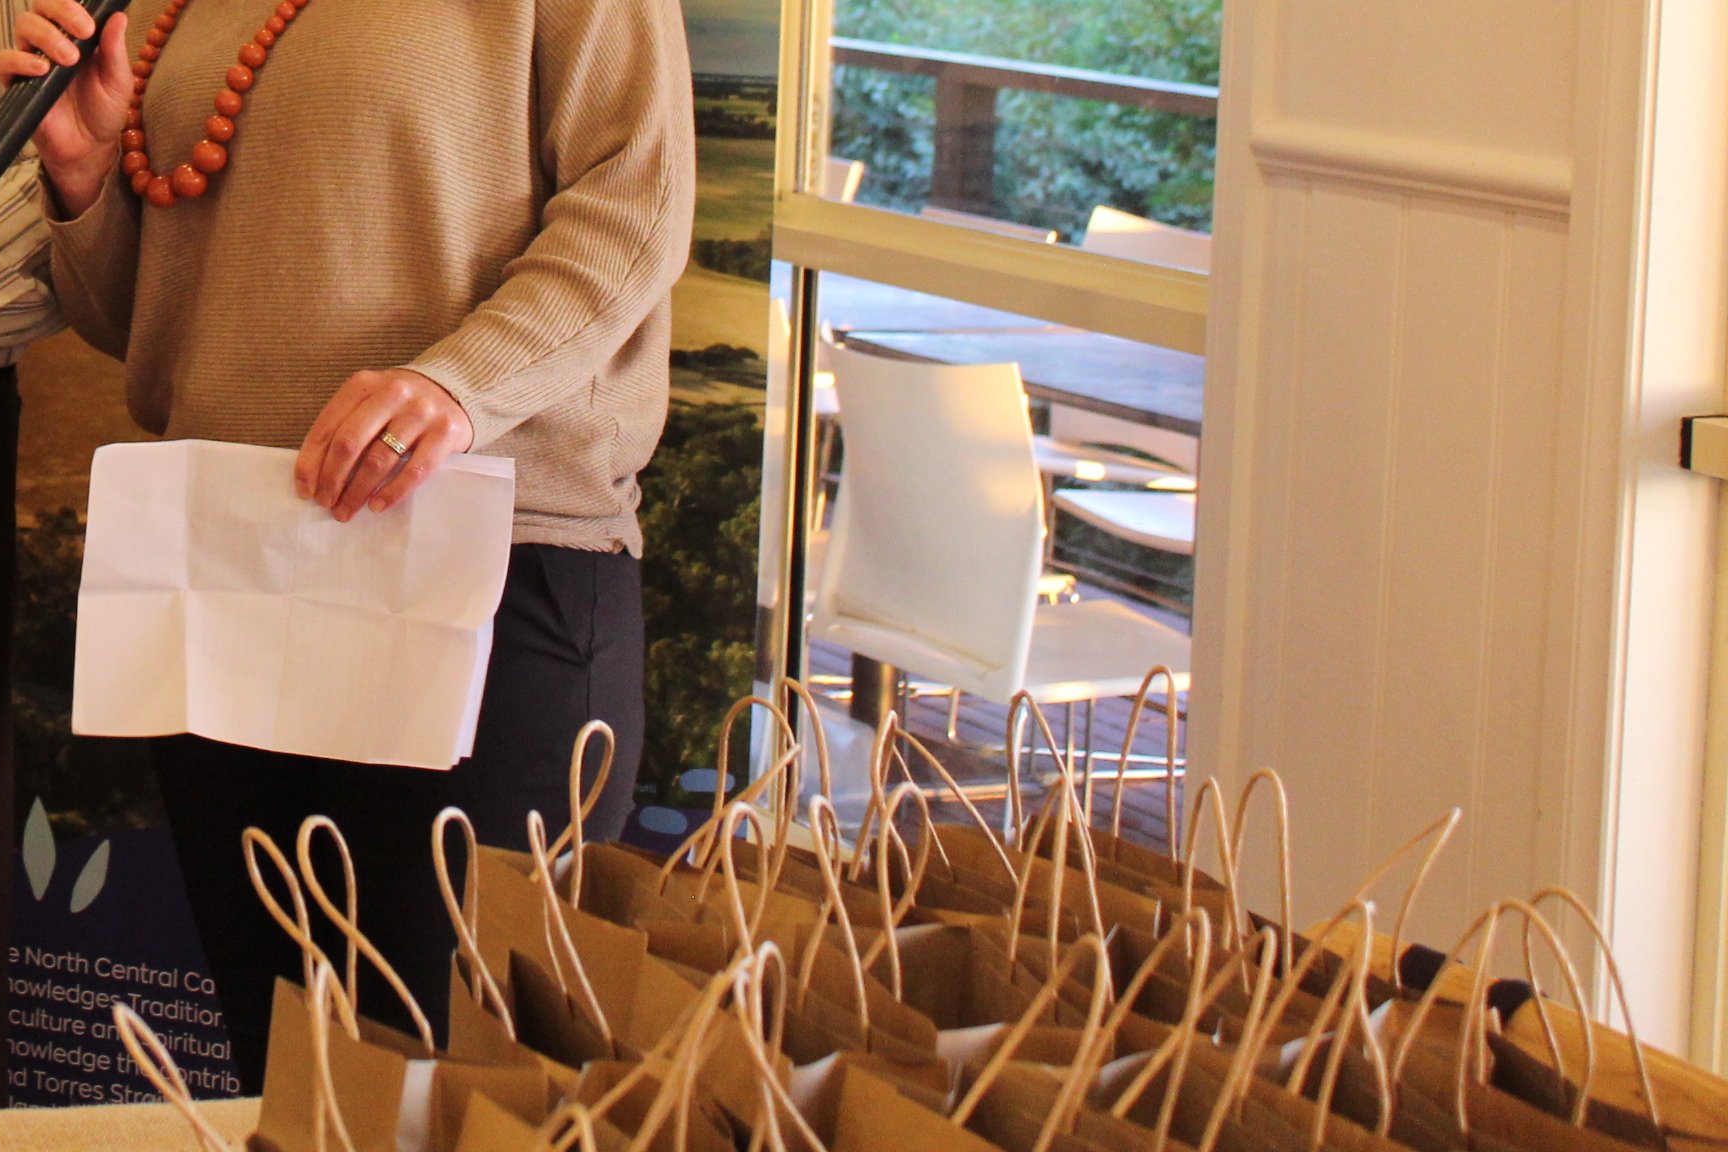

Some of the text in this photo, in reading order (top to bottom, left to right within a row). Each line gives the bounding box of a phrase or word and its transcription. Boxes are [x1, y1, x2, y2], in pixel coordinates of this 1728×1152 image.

[25, 947, 89, 974] North
[95, 957, 178, 988] Central
[184, 972, 216, 995] Ca
[8, 1008, 86, 1036] culture
[91, 1022, 122, 1041] an
[117, 1052, 147, 1078] th
[33, 1070, 104, 1100] Torres
